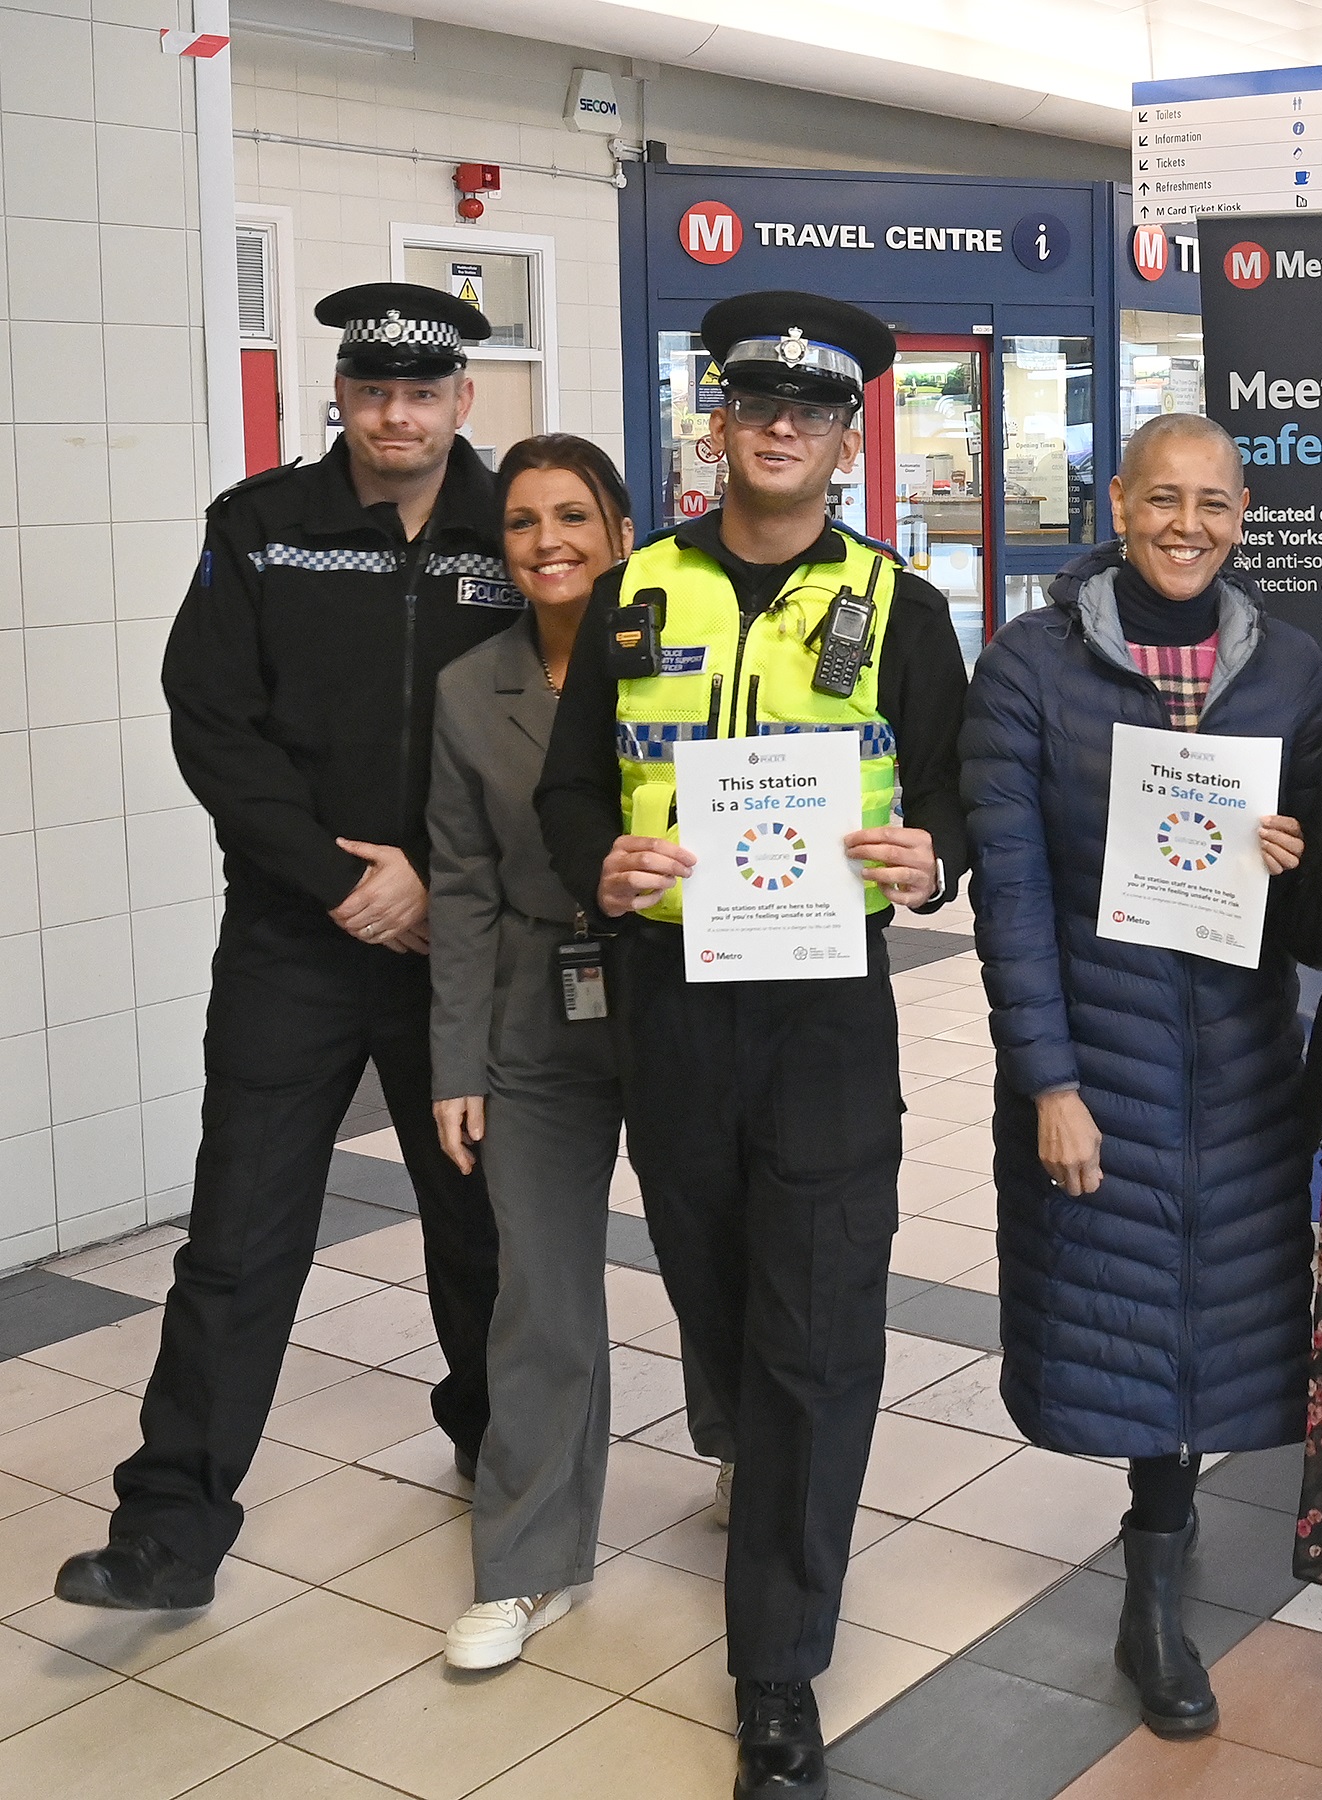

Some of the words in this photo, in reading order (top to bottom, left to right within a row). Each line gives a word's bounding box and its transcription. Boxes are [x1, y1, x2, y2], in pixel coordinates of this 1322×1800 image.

[580, 98, 616, 115] SECOM
[1156, 110, 1181, 120] Toilets
[1155, 132, 1202, 144] Information
[1156, 158, 1185, 168] Tickets
[1156, 181, 1212, 192] Refreshments
[1156, 208, 1164, 216] M
[1168, 206, 1187, 215] Card
[1190, 204, 1214, 214] Ticket
[1218, 203, 1241, 212] Kiosk
[689, 214, 732, 252] M
[755, 222, 874, 249] TRAVEL
[885, 226, 1002, 252] CENTRE
[1139, 231, 1163, 269] M
[1232, 251, 1261, 279] M
[684, 495, 703, 512] M
[1243, 505, 1315, 522] edicated
[1256, 576, 1318, 592] tection
[462, 583, 521, 603] POLICE
[719, 777, 754, 791] This
[760, 774, 817, 789] station
[1151, 764, 1182, 780] This
[1187, 773, 1240, 789] station
[1142, 780, 1153, 792] is
[1158, 786, 1166, 795] a
[1171, 786, 1203, 802] Safe
[1209, 793, 1246, 808] Zone
[712, 799, 724, 812] is
[730, 801, 738, 811] a
[744, 796, 779, 810] Safe
[785, 796, 826, 808] Zone
[1127, 915, 1150, 925] Metro
